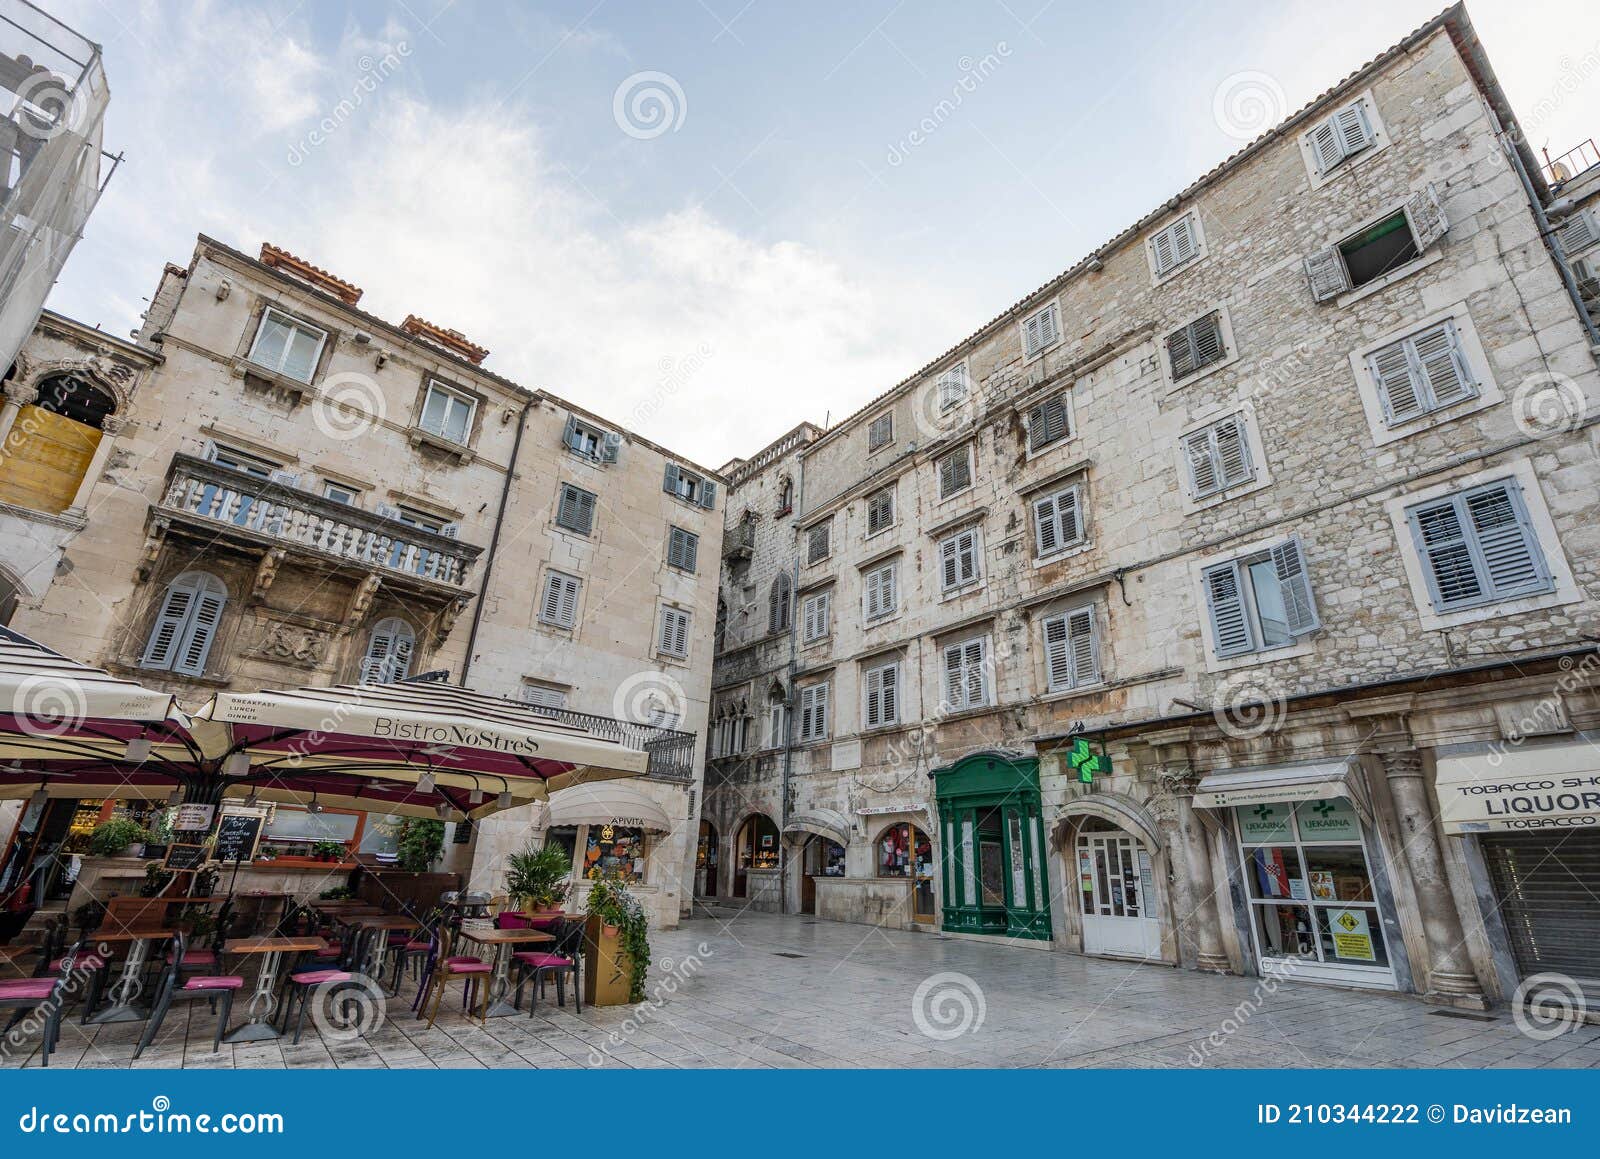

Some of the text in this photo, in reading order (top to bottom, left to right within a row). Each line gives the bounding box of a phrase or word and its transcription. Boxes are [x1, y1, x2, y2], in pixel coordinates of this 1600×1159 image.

[231, 698, 277, 708] BREAKFAST
[227, 713, 257, 721] DINNER
[1457, 780, 1555, 796] TOBACCO
[1485, 792, 1600, 815] LIQUOR
[610, 817, 645, 826] APIVITA
[1501, 816, 1597, 829] TOBACCO
